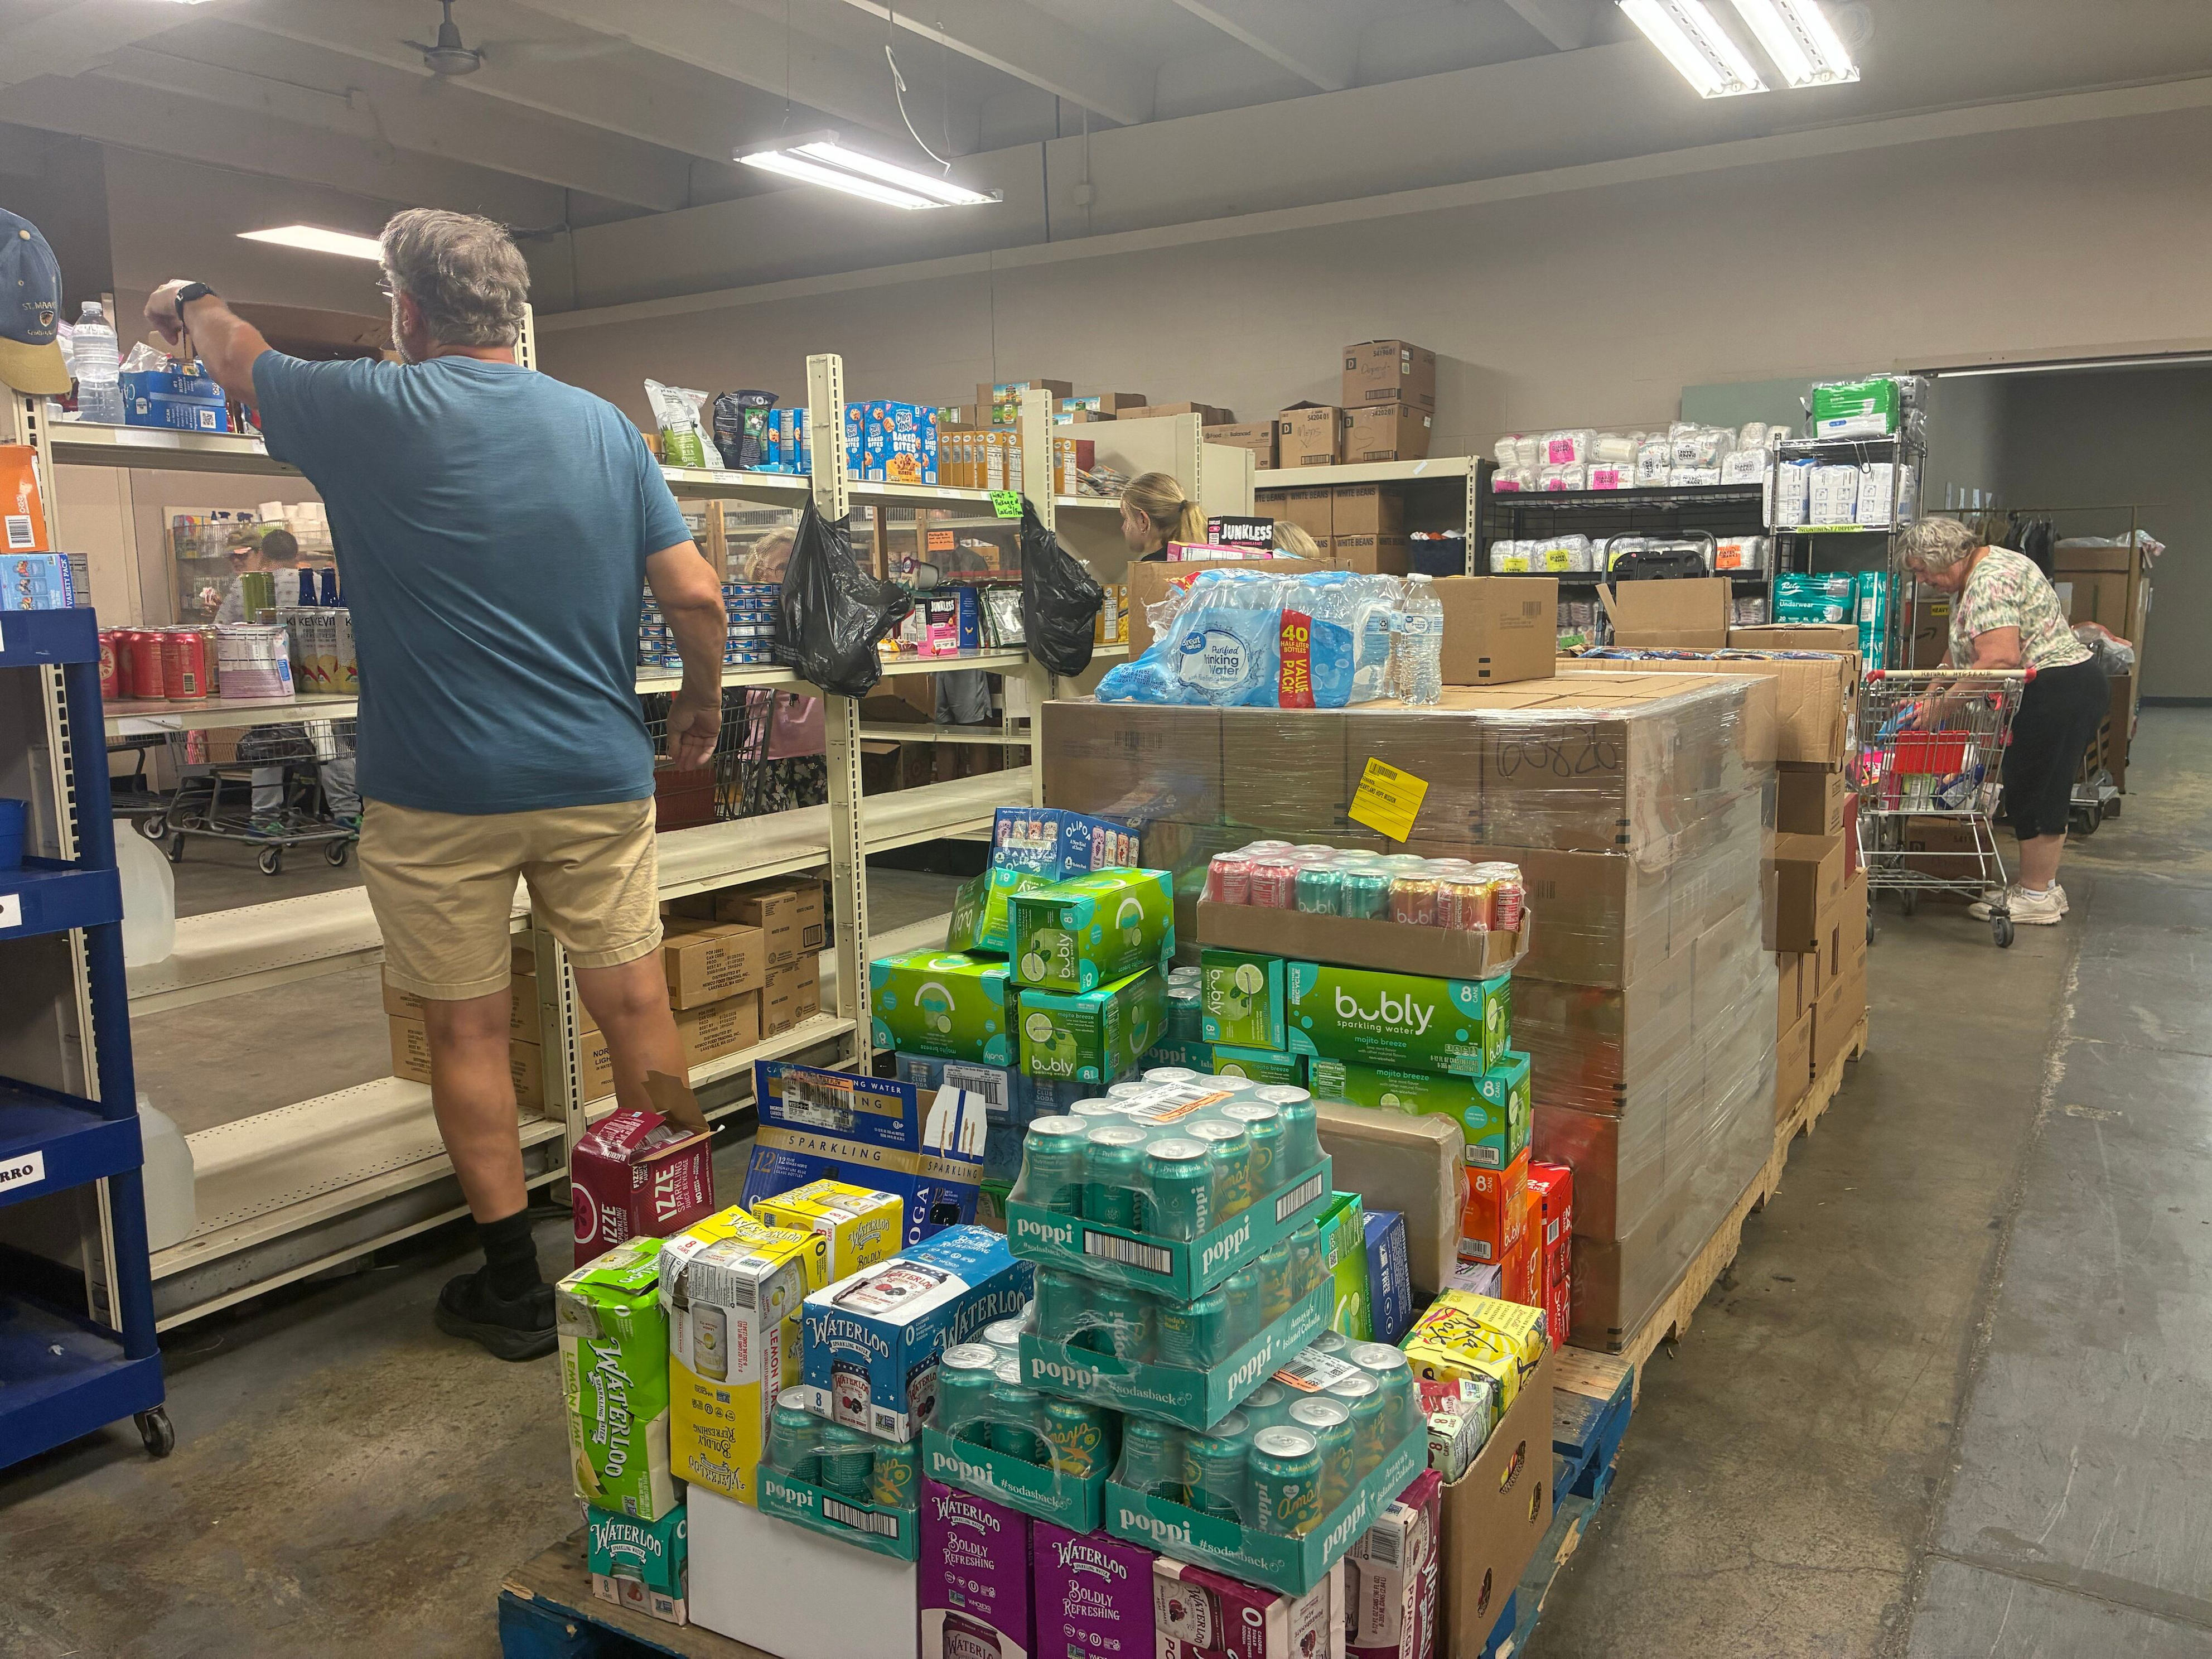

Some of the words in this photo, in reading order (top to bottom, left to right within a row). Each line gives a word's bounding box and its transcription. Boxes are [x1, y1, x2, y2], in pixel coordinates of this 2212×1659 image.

[1348, 360, 1354, 368] D
[1345, 418, 1351, 427] D
[893, 431, 916, 443] BAKED
[894, 441, 916, 453] BITES
[1291, 491, 1309, 500] WHITE
[1311, 490, 1328, 499] BEANS
[1337, 489, 1355, 498] WHITE
[1221, 524, 1272, 541] JUNKLESS
[1337, 538, 1355, 547] WHITE
[1355, 538, 1373, 546] BEANS
[64, 577, 73, 605] VARIETY
[931, 600, 954, 612] JUNKLESS
[1282, 624, 1308, 642] 40
[1211, 645, 1238, 655] Purified
[1295, 659, 1308, 693] VALUE
[1384, 794, 1396, 803] MISSION
[1066, 820, 1091, 841] OLIPOP
[1057, 933, 1073, 978] bubly
[712, 971, 733, 980] DISTRIBUTED
[1086, 972, 1092, 987] 8
[1208, 969, 1224, 1015] bubly
[1460, 986, 1472, 1002] 8
[1336, 986, 1435, 1035] bubly
[1337, 1020, 1382, 1034] sparkling
[1385, 1026, 1414, 1035] water
[1355, 1036, 1378, 1046] mojito
[1380, 1039, 1407, 1048] breeze
[985, 1051, 1004, 1061] bubly
[1032, 1056, 1073, 1077] bubly
[1083, 1069, 1090, 1079] 8
[1377, 1068, 1401, 1077] mojito
[1403, 1072, 1429, 1081] breeze
[1483, 1081, 1494, 1097] 8
[789, 1136, 882, 1161] SPARKLING
[754, 1150, 776, 1173] 12
[928, 1161, 978, 1179] SPARKLING
[655, 1165, 677, 1223] IZZE
[675, 1160, 685, 1213] SPARKLING
[1475, 1175, 1487, 1192] 8
[1527, 1179, 1551, 1188] 24
[602, 1202, 618, 1244] IZZE
[720, 1211, 803, 1244] WATERLOO
[1017, 1218, 1073, 1245] poppi
[848, 1218, 890, 1254] WATERLOO
[1202, 1215, 1250, 1275] poppi
[677, 1245, 690, 1255] CANS
[857, 1249, 882, 1272] BOLDLY
[1023, 1242, 1060, 1257] #sodasback
[883, 1270, 933, 1289] WATERLOO
[934, 1290, 1027, 1351] WATERLOO
[1290, 1303, 1315, 1330] Amaya's
[806, 1307, 890, 1359] WATERLOO
[906, 1325, 914, 1346] 0
[1282, 1329, 1302, 1351] Island
[1301, 1315, 1321, 1339] Colada
[832, 1340, 855, 1351] SPARKLING
[855, 1347, 870, 1357] WATER
[566, 1351, 579, 1407] LEMON
[1031, 1356, 1099, 1390] poppi
[1228, 1334, 1272, 1402] poppi
[837, 1372, 869, 1396] WATERLOO
[1108, 1382, 1177, 1406] #sodasback
[588, 1336, 634, 1479] WATERLOO
[816, 1392, 822, 1406] 8
[571, 1412, 582, 1449] LIME
[693, 1424, 736, 1443] REFRESHING
[698, 1435, 731, 1458] BOLDLY
[1429, 1441, 1443, 1451] 8
[688, 1455, 746, 1491] WATERLOO
[933, 1451, 993, 1486] poppi
[1377, 1479, 1397, 1502] Island
[1395, 1459, 1416, 1488] Colada
[765, 1480, 813, 1507] poppi
[1000, 1479, 1060, 1507] #sodasback
[931, 1496, 1001, 1532] WATERLOO
[952, 1516, 971, 1526] SPARKLING
[971, 1521, 985, 1531] WATER
[590, 1517, 661, 1557] WATERLOO
[1119, 1508, 1192, 1544] poppi
[1322, 1489, 1367, 1565] poppi
[948, 1531, 988, 1557] BOLDLY
[1199, 1539, 1269, 1571] #sodasback
[943, 1548, 995, 1570] REFRESHING
[1051, 1538, 1127, 1580] WATERLOO
[1074, 1563, 1096, 1573] SPARKLING
[1096, 1569, 1110, 1578] WATER
[603, 1580, 608, 1592] 8
[1068, 1579, 1113, 1608] BOLDLY
[1062, 1597, 1121, 1621] REFRESHING
[1186, 1588, 1205, 1646] WATERLOO
[1242, 1607, 1262, 1627] 0
